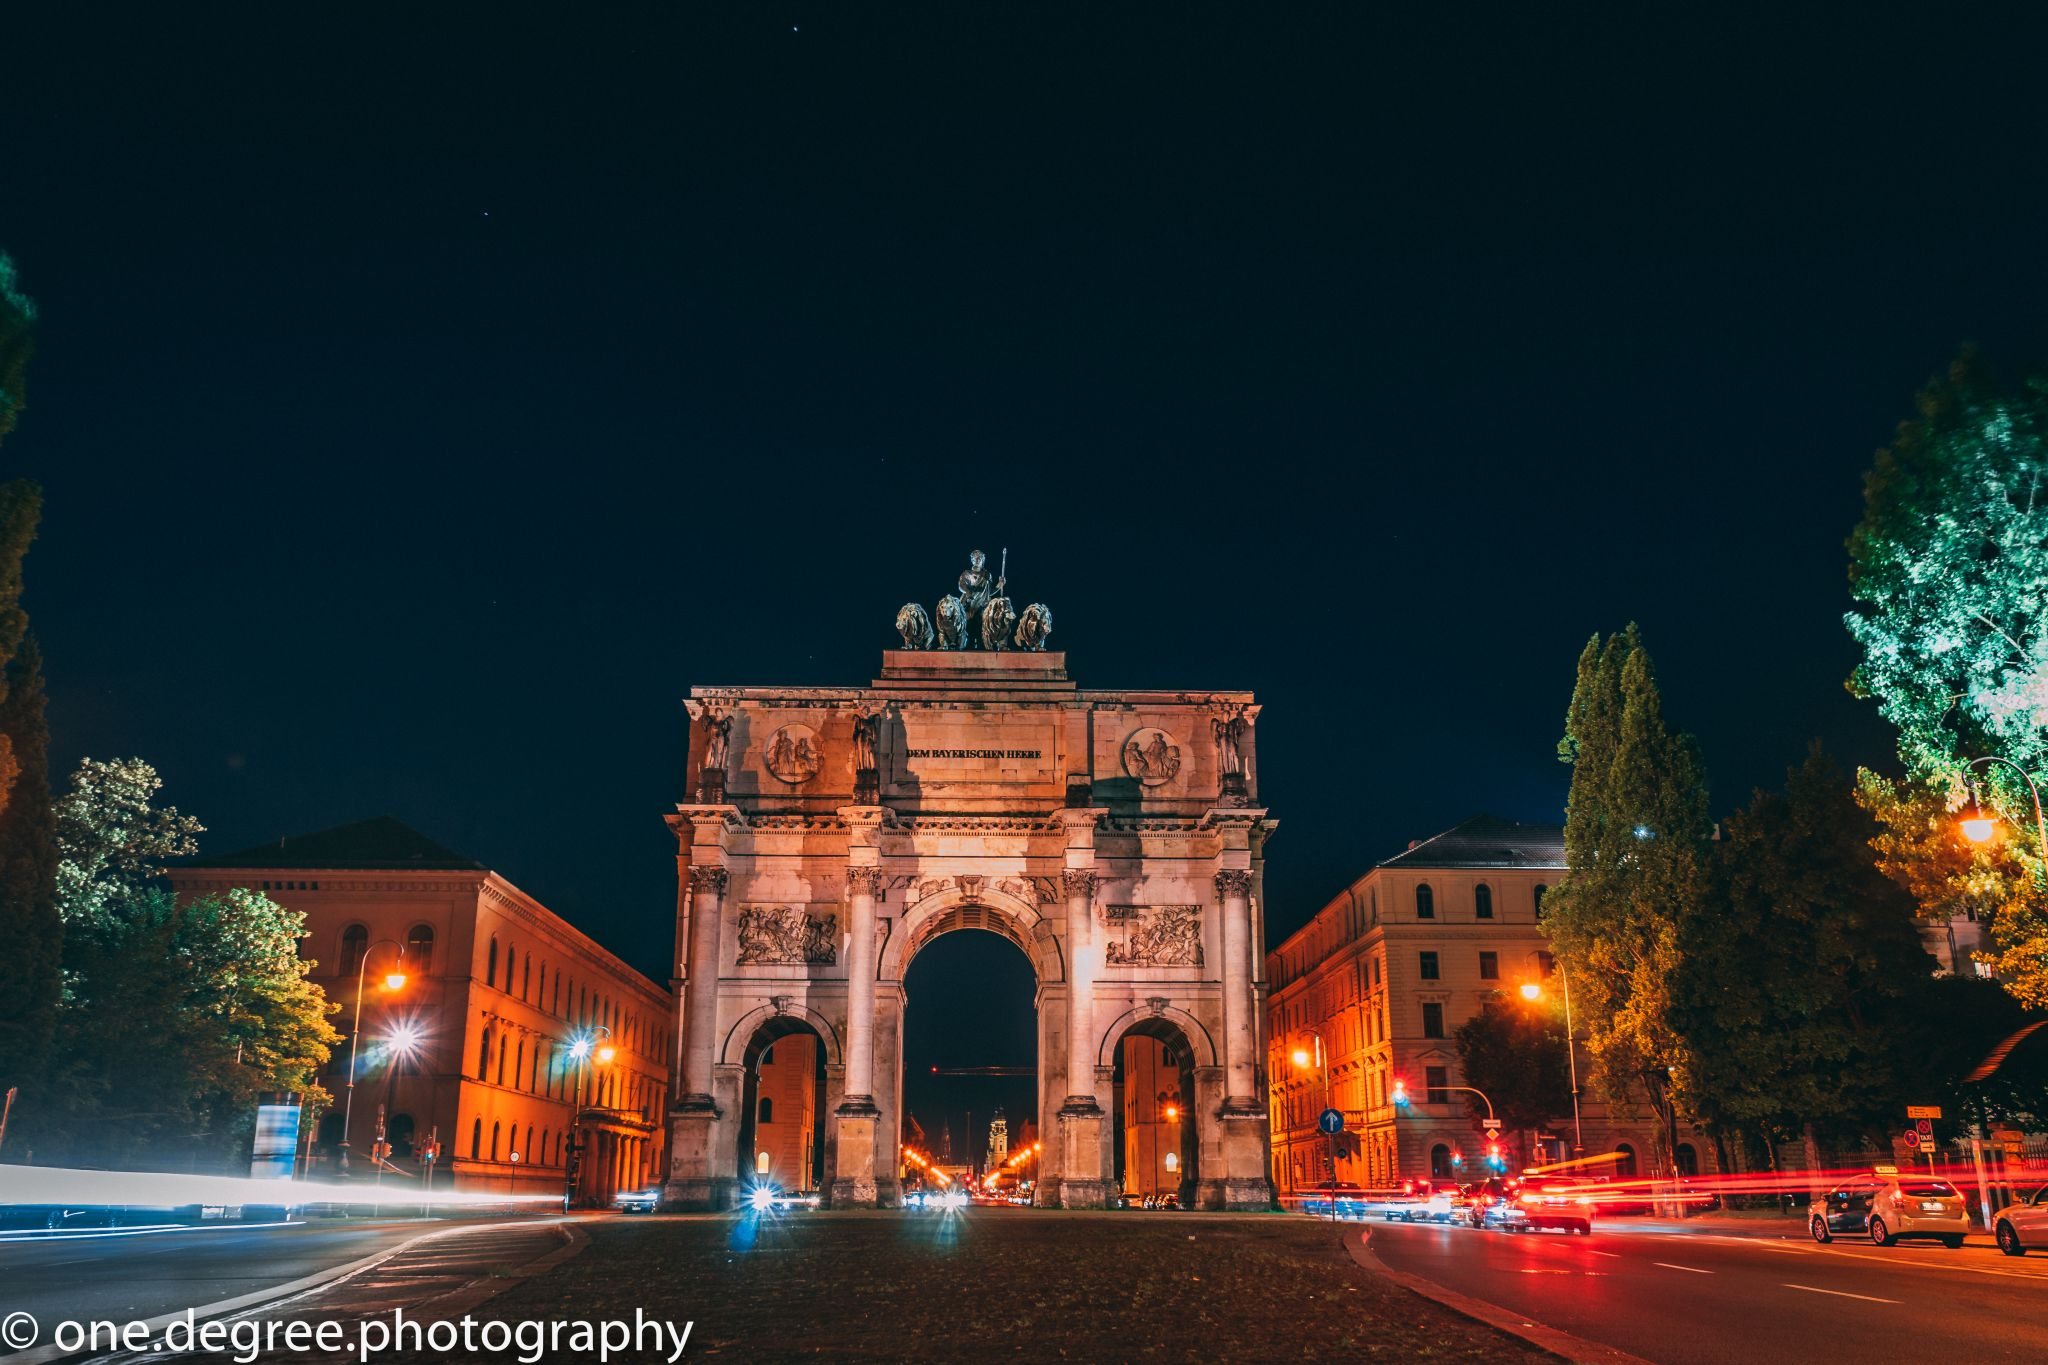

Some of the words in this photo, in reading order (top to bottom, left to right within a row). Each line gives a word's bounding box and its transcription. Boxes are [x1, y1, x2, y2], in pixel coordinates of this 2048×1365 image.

[906, 749, 930, 758] DEM
[932, 749, 1005, 759] BAYERISCHEN
[1007, 750, 1042, 759] HEERE
